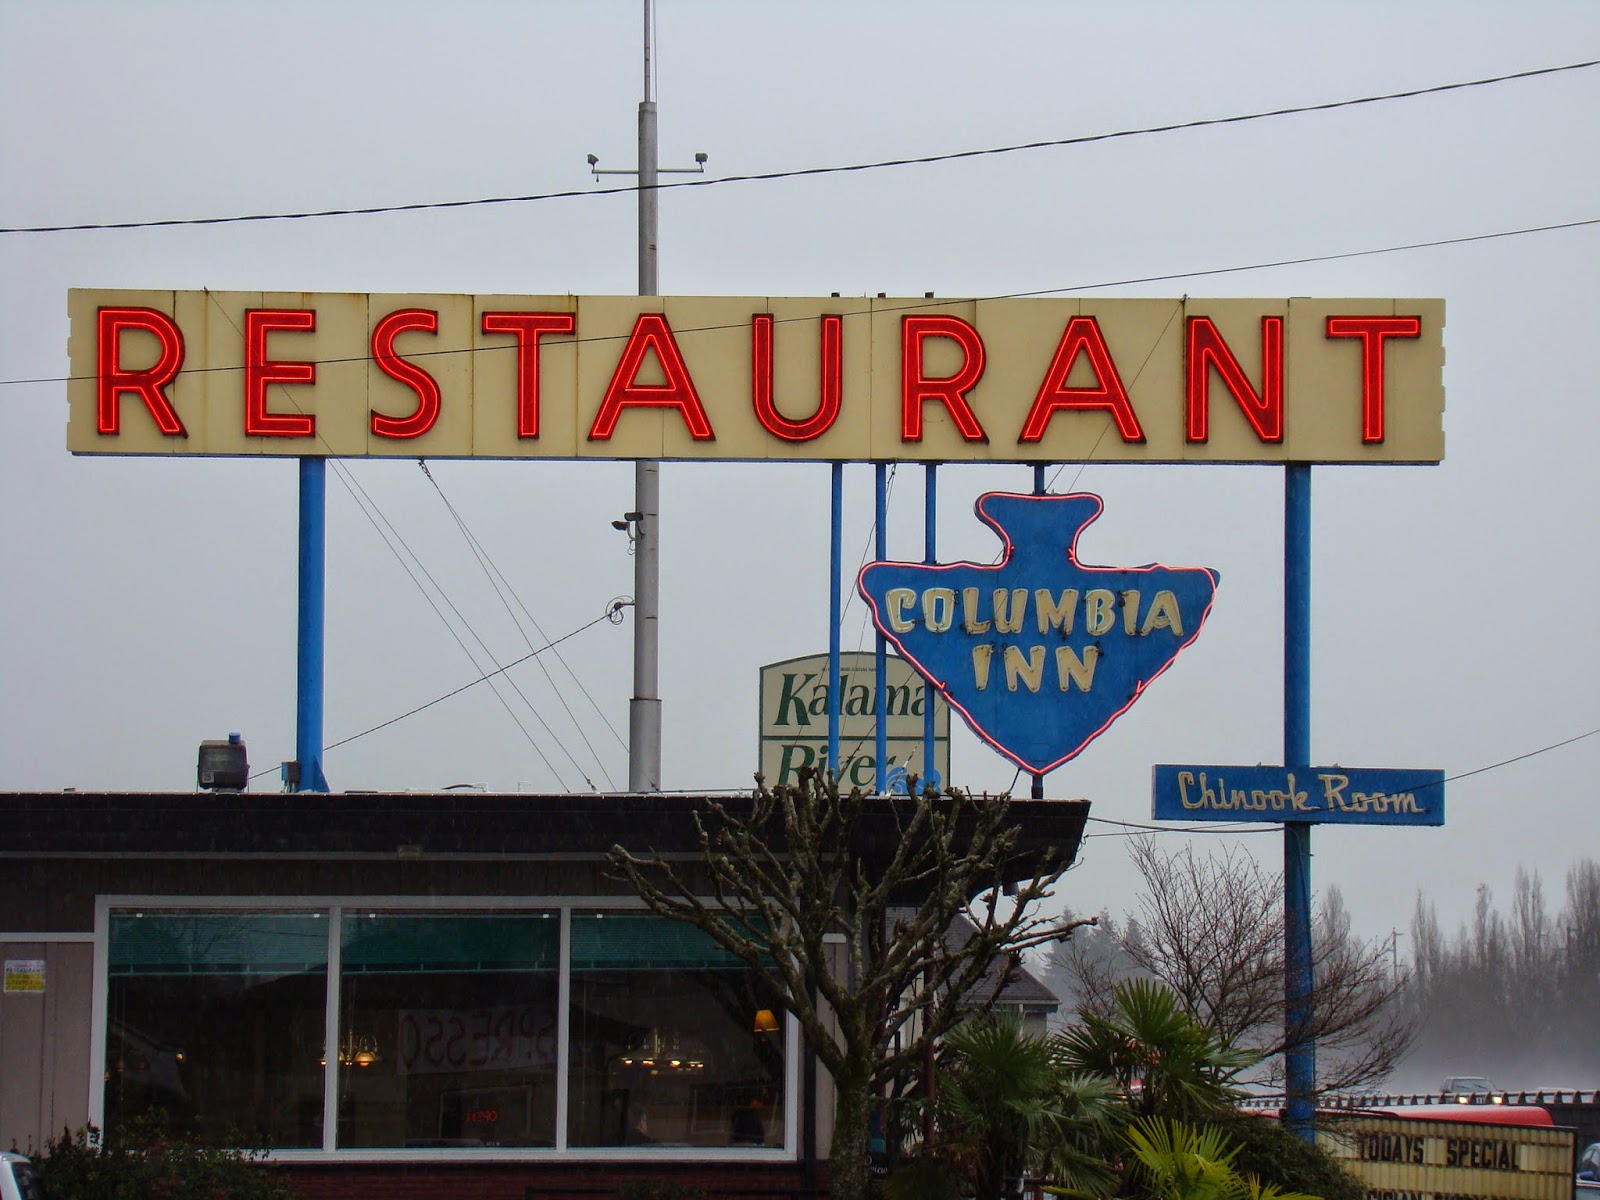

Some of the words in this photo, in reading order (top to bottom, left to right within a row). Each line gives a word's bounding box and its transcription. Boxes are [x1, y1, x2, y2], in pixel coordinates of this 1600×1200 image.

[96, 305, 1421, 444] RESTAURANT
[885, 586, 1183, 638] COLUMBIA
[973, 643, 1102, 693] INN
[1177, 771, 1321, 811] Chinook
[1317, 773, 1428, 814] Room
[1447, 1138, 1520, 1170] SPECIAL
